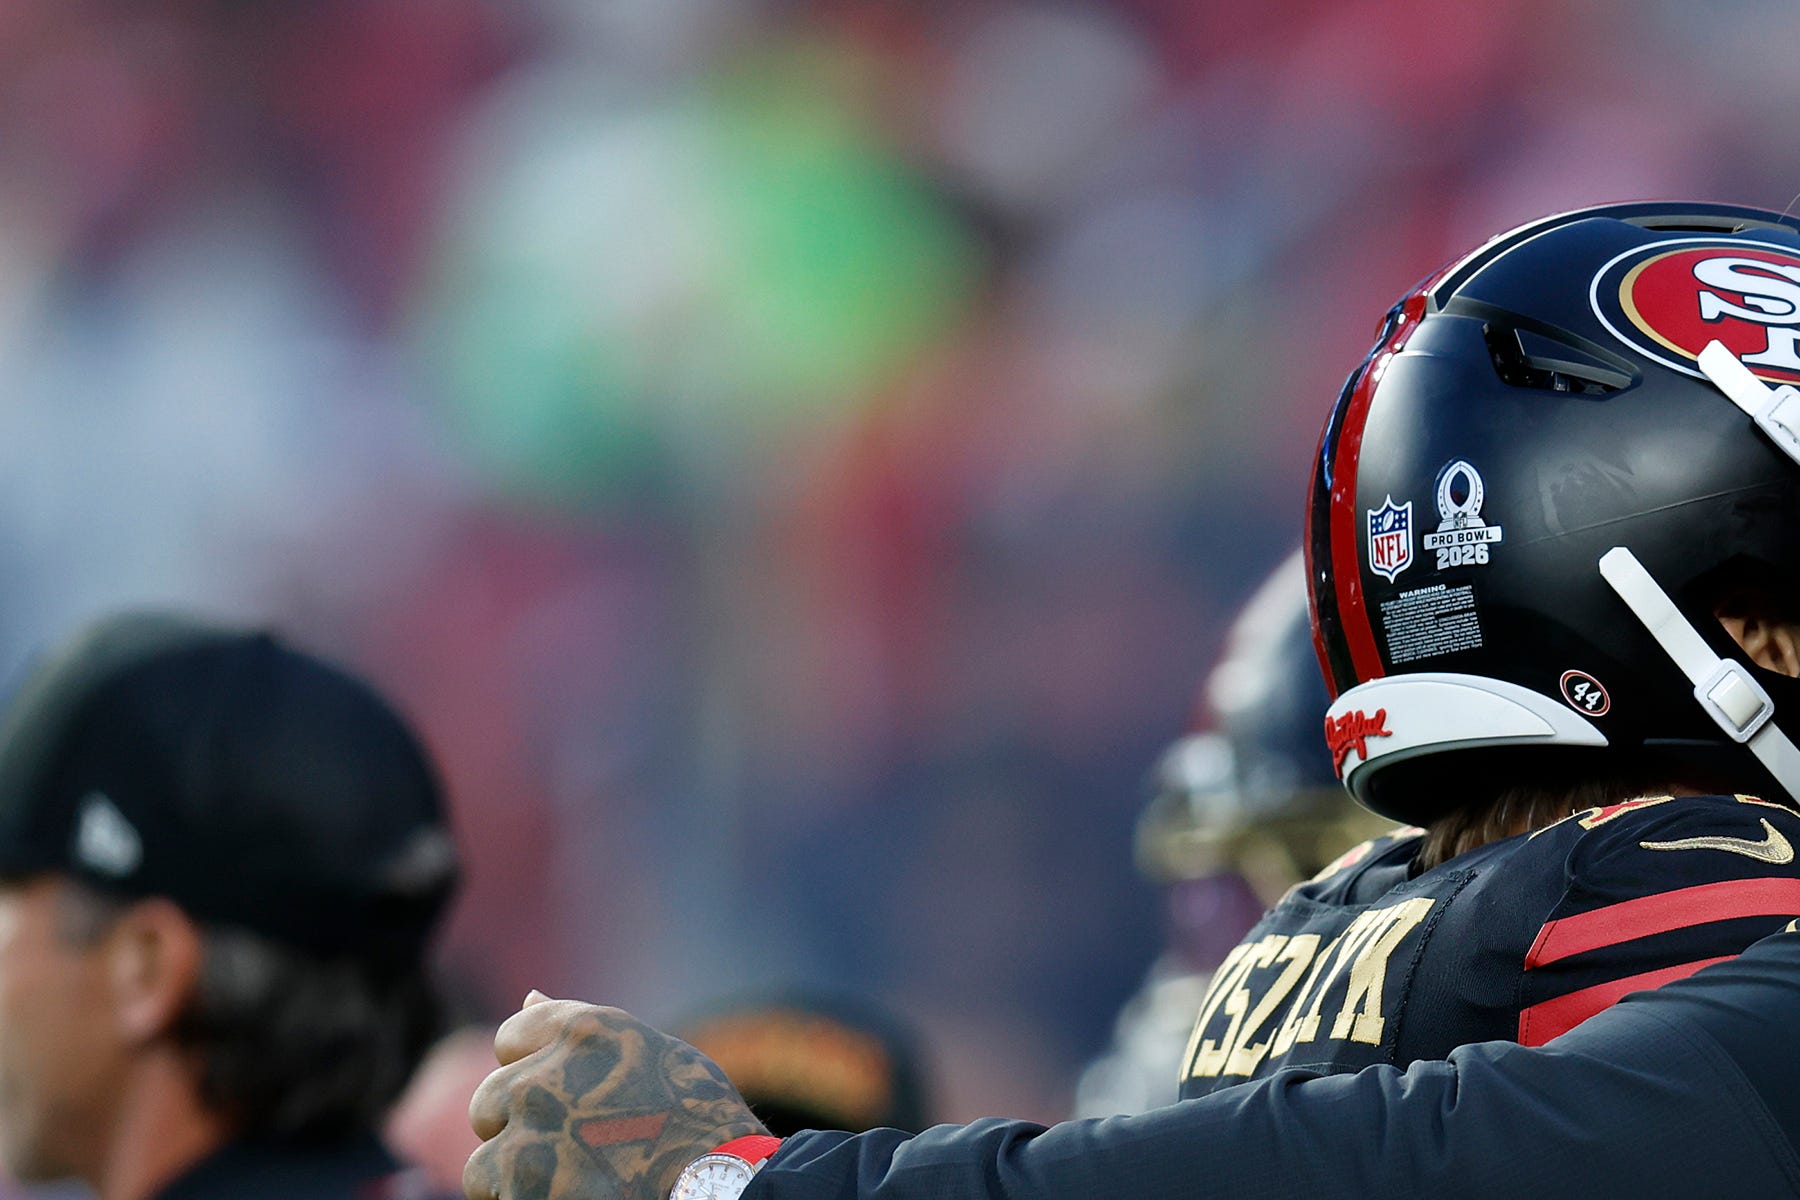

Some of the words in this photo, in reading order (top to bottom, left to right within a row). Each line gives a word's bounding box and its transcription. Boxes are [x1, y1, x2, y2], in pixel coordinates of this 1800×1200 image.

[1373, 533, 1406, 567] NFL
[1431, 535, 1454, 546] PRO
[1457, 531, 1493, 542] BOWL
[1436, 543, 1490, 571] 2026
[1399, 584, 1447, 599] WARNING
[1574, 682, 1602, 710] 44
